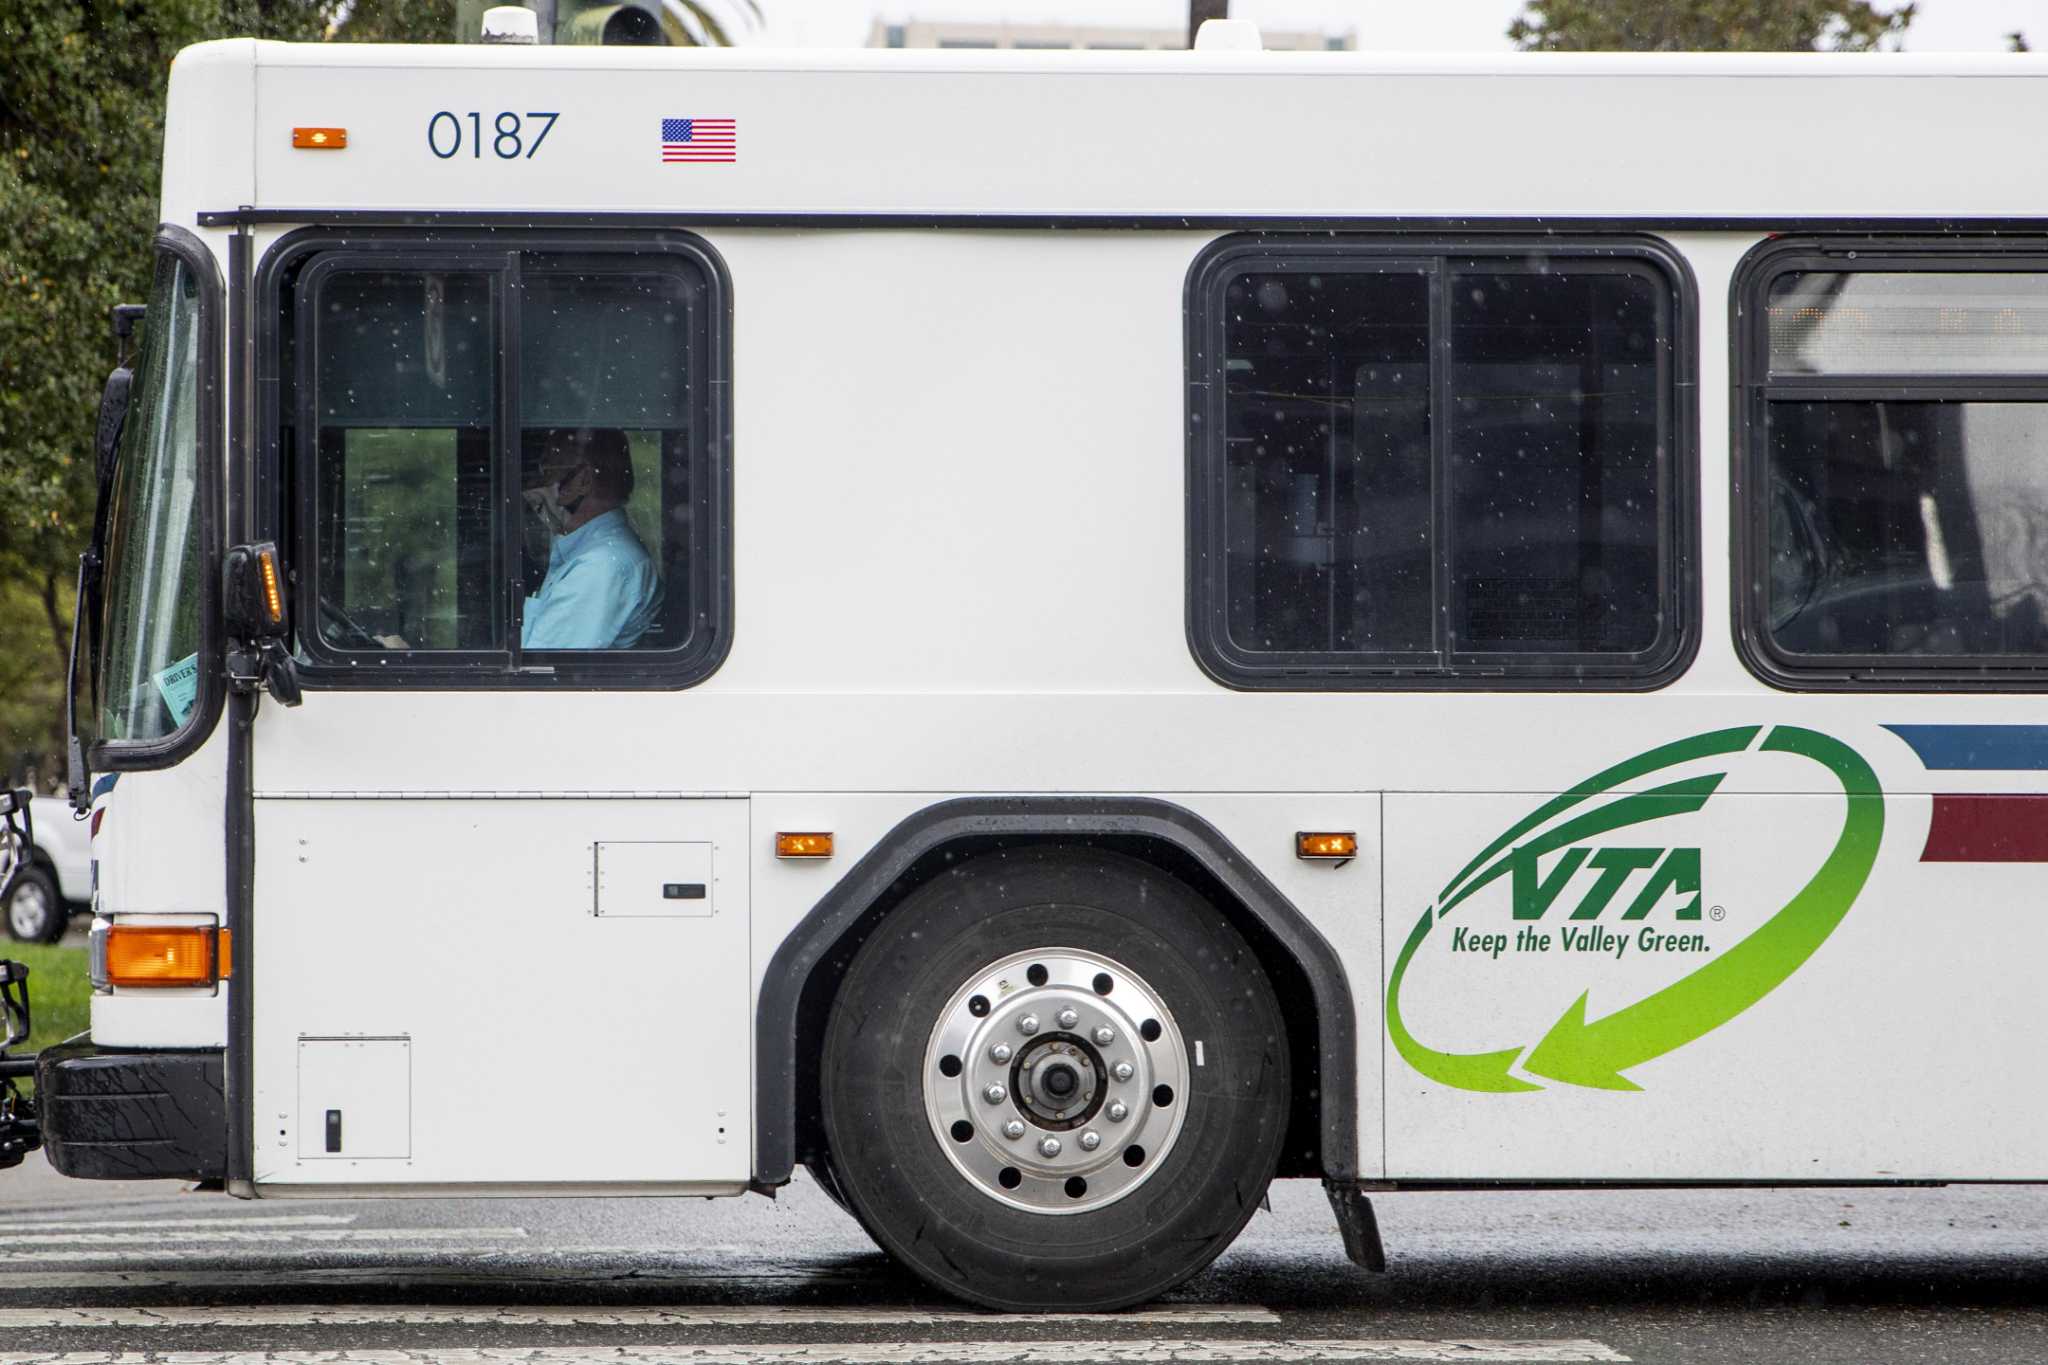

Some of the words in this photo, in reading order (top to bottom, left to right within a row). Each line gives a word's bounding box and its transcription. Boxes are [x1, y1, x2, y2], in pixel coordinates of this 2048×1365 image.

[428, 111, 560, 159] 0187
[1512, 847, 1702, 921] VTA
[1452, 926, 1508, 959] Keep
[1516, 925, 1551, 952] the
[1561, 925, 1630, 960] Valley
[1638, 926, 1711, 952] Green.
